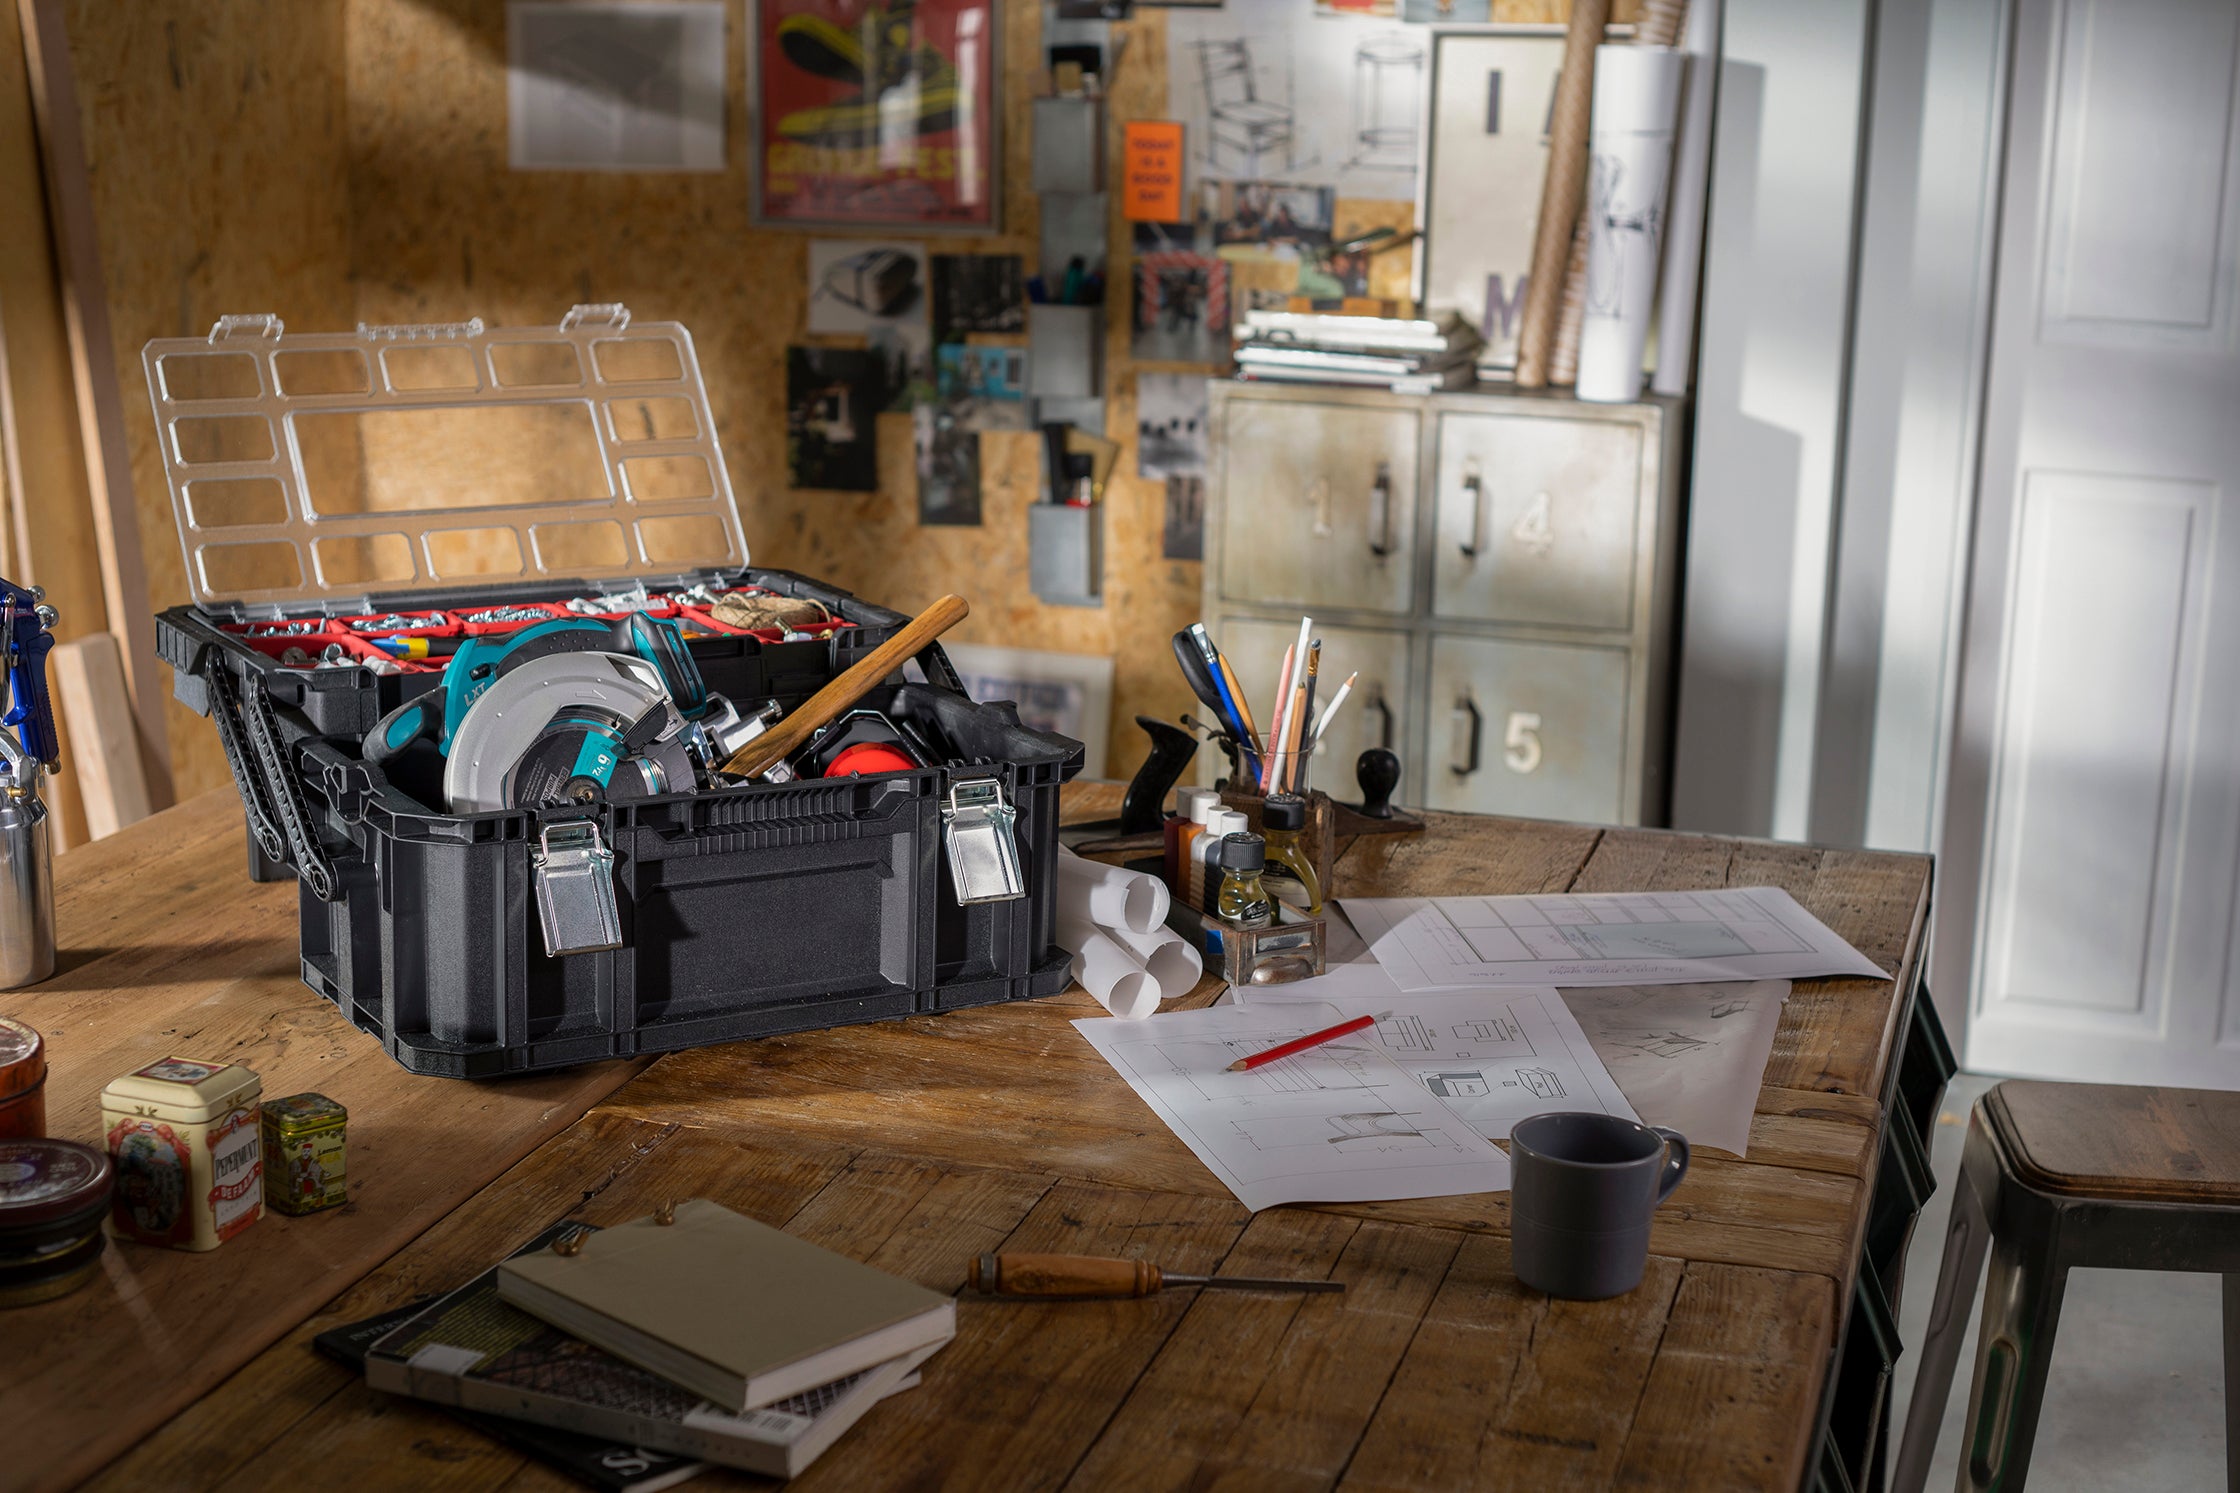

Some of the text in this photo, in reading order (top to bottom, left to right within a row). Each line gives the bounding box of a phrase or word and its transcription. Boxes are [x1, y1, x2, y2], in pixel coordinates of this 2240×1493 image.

[1307, 476, 1332, 538] 1
[1512, 491, 1555, 556] 4
[463, 681, 486, 708] LXT
[1504, 711, 1543, 774] 5
[318, 1144, 343, 1156] Lemon
